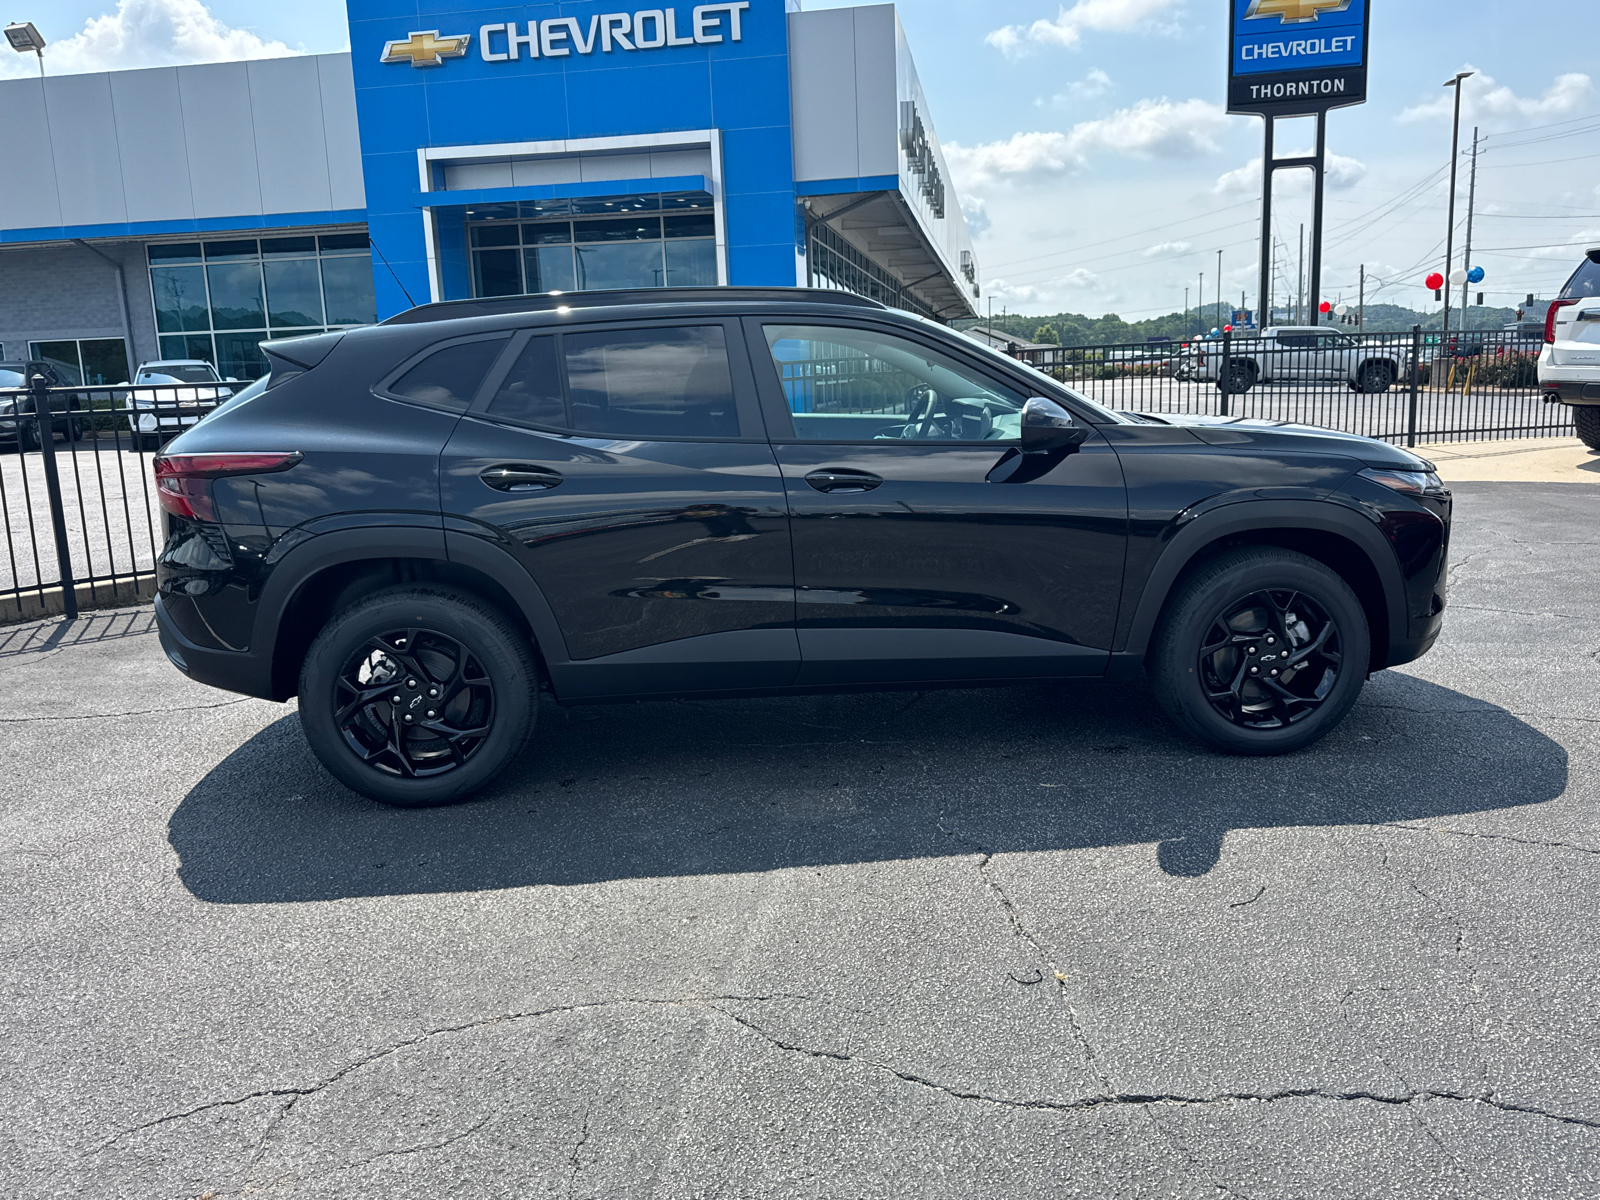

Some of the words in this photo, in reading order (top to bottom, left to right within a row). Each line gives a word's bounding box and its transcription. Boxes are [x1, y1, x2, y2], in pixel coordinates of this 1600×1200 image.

[479, 1, 750, 62] CHEVROLET
[1241, 35, 1356, 61] CHEVROLET
[1250, 78, 1345, 99] THORNTON
